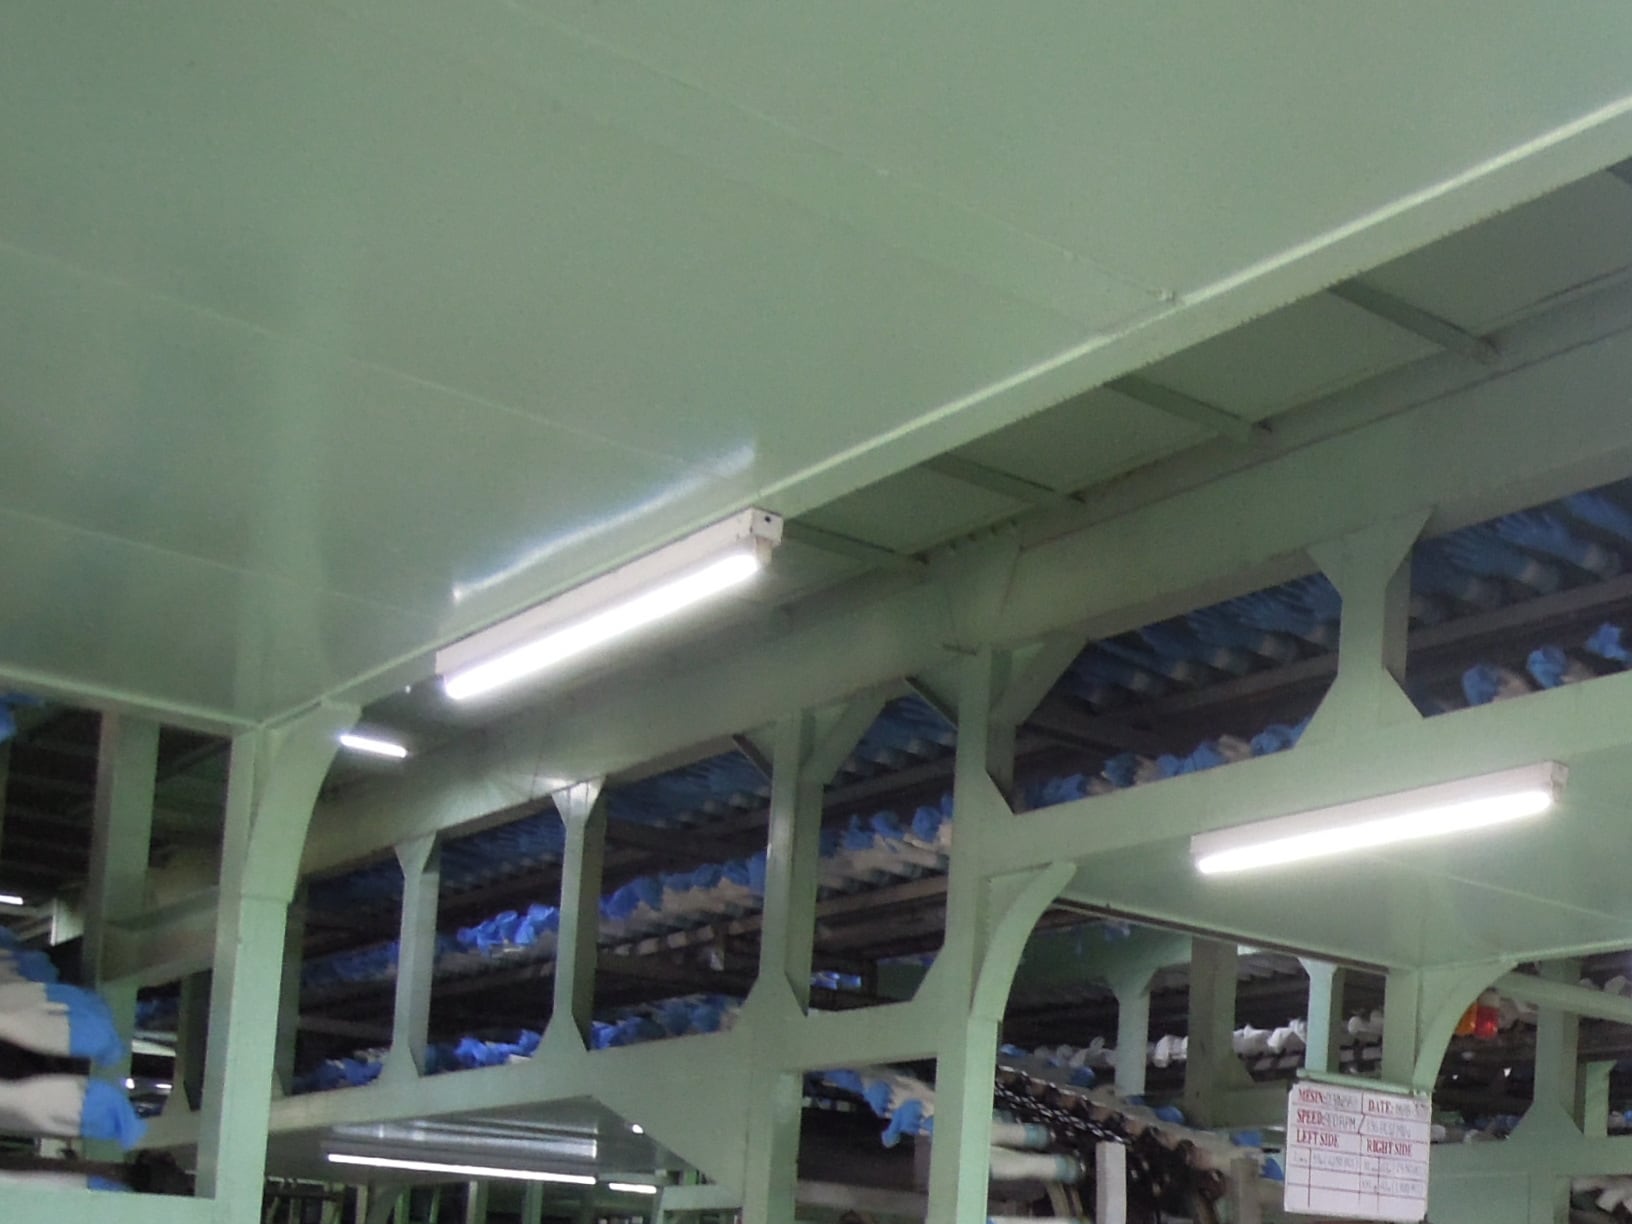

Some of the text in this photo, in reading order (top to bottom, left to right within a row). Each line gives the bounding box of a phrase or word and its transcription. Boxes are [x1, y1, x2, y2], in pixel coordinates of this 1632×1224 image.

[1296, 1130, 1338, 1148] LEFT SIDE
[1366, 1139, 1413, 1157] RIGHT SIDE
